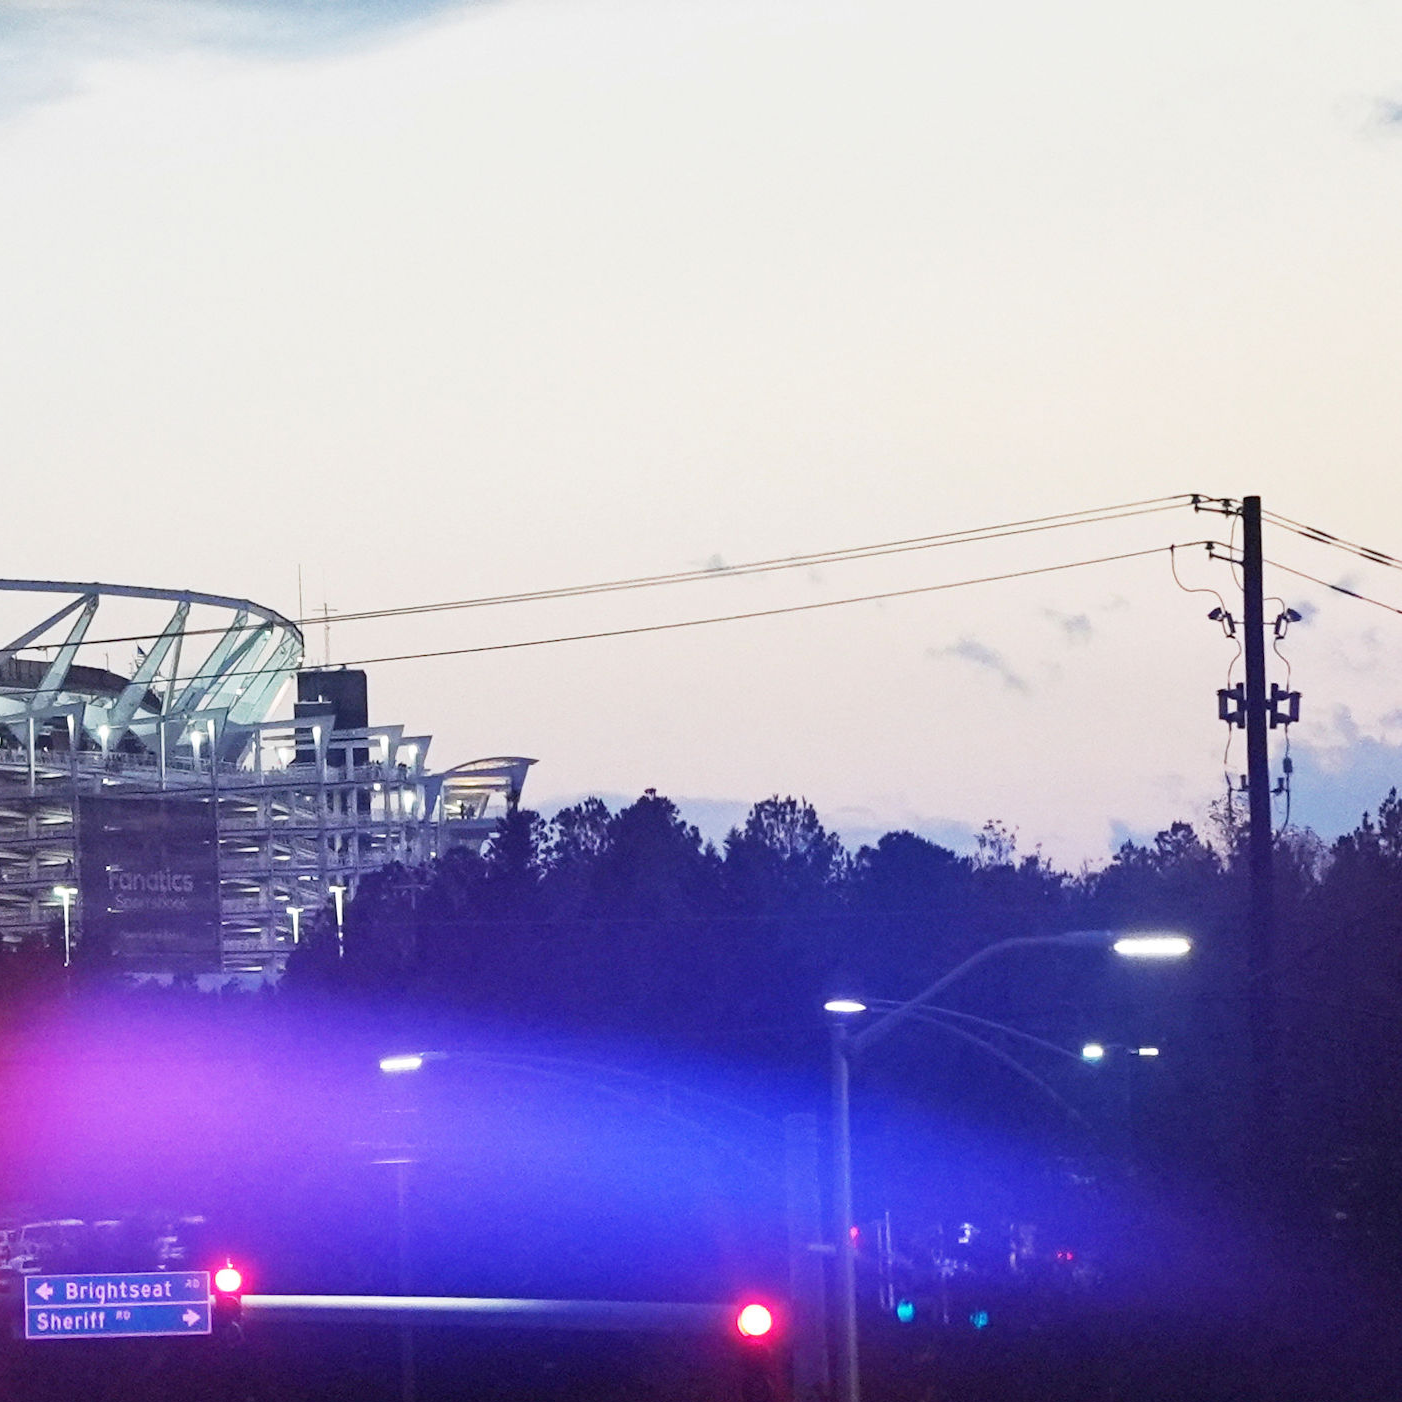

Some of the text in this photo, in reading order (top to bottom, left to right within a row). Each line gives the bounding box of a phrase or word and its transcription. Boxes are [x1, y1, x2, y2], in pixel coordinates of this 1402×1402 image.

[109, 866, 195, 894] Fanatics
[65, 1278, 200, 1305] Brightseat RD
[37, 1309, 131, 1331] Sheriff RD
